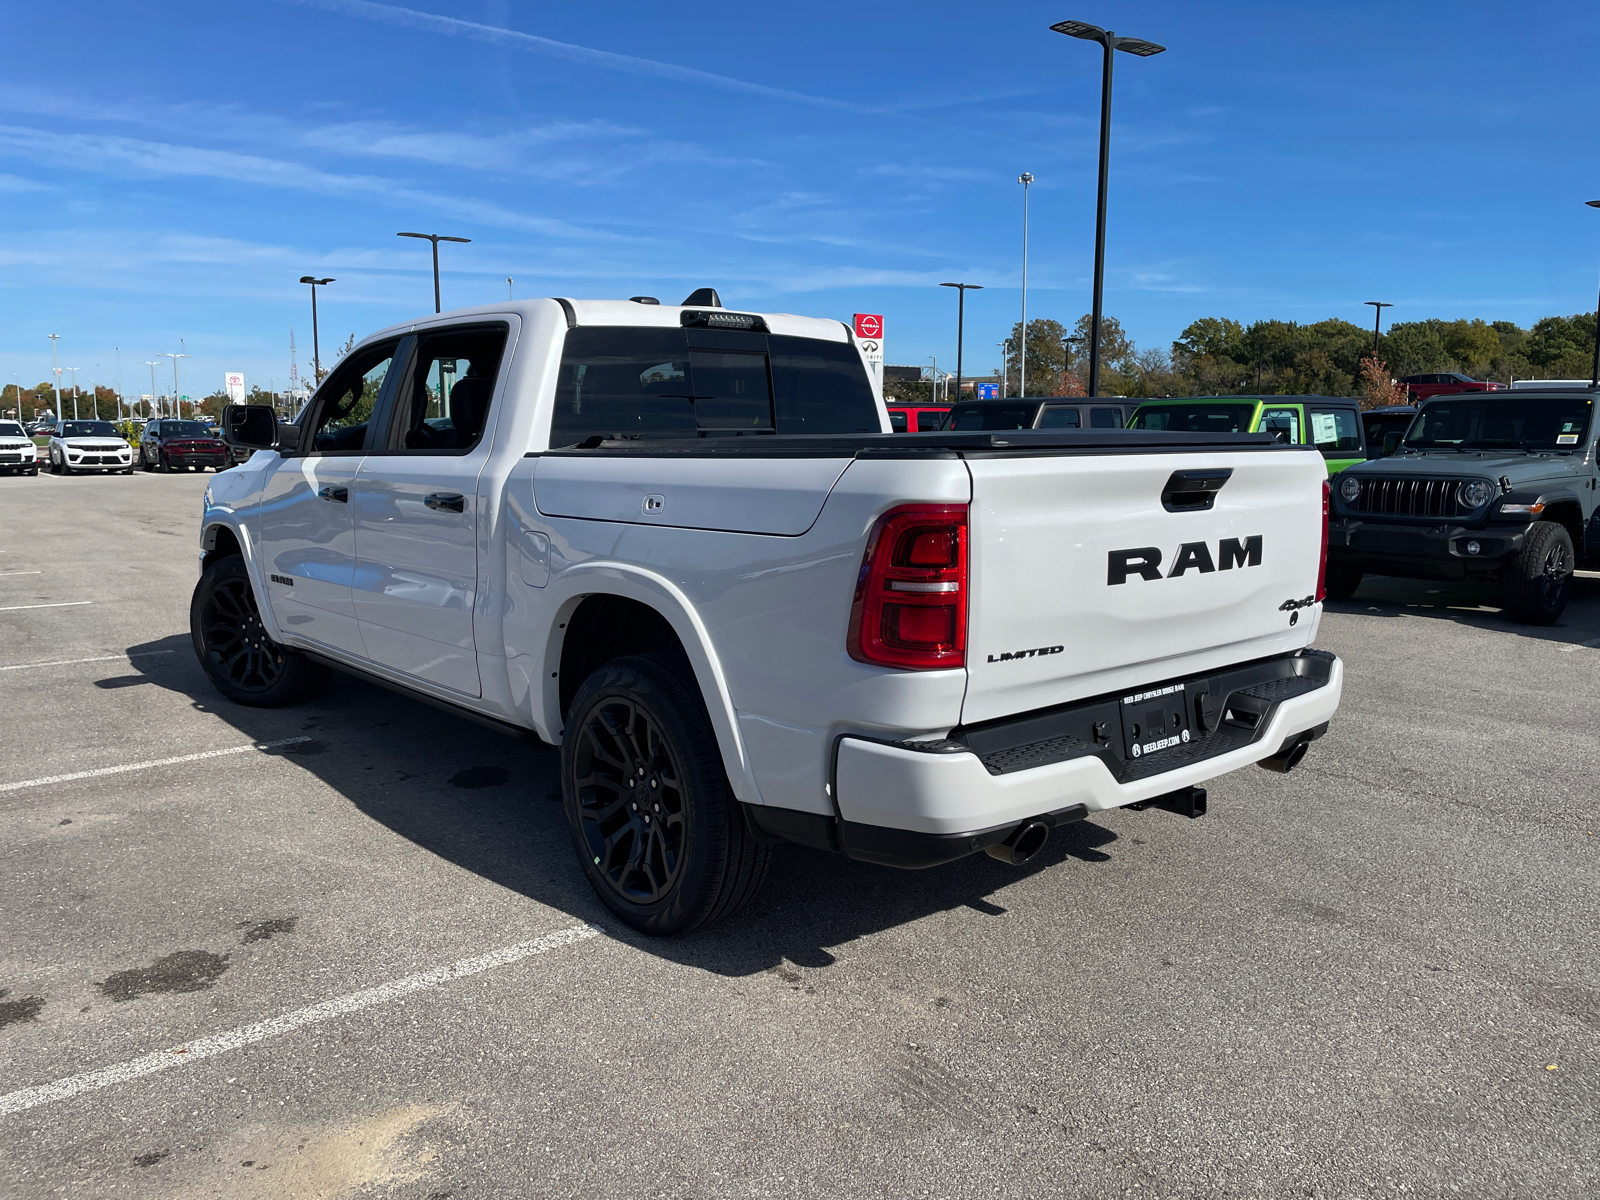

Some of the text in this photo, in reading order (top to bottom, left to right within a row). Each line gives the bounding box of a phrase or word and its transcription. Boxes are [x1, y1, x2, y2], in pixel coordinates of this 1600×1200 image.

[1107, 534, 1263, 587] RAM
[986, 645, 1065, 663] LIMITED
[1134, 693, 1143, 702] JEEP
[1143, 689, 1162, 699] CHRYSLER
[1162, 685, 1175, 695] DODGE
[1175, 683, 1185, 691] RAM
[1143, 735, 1181, 754] REEDJEEP.COM
